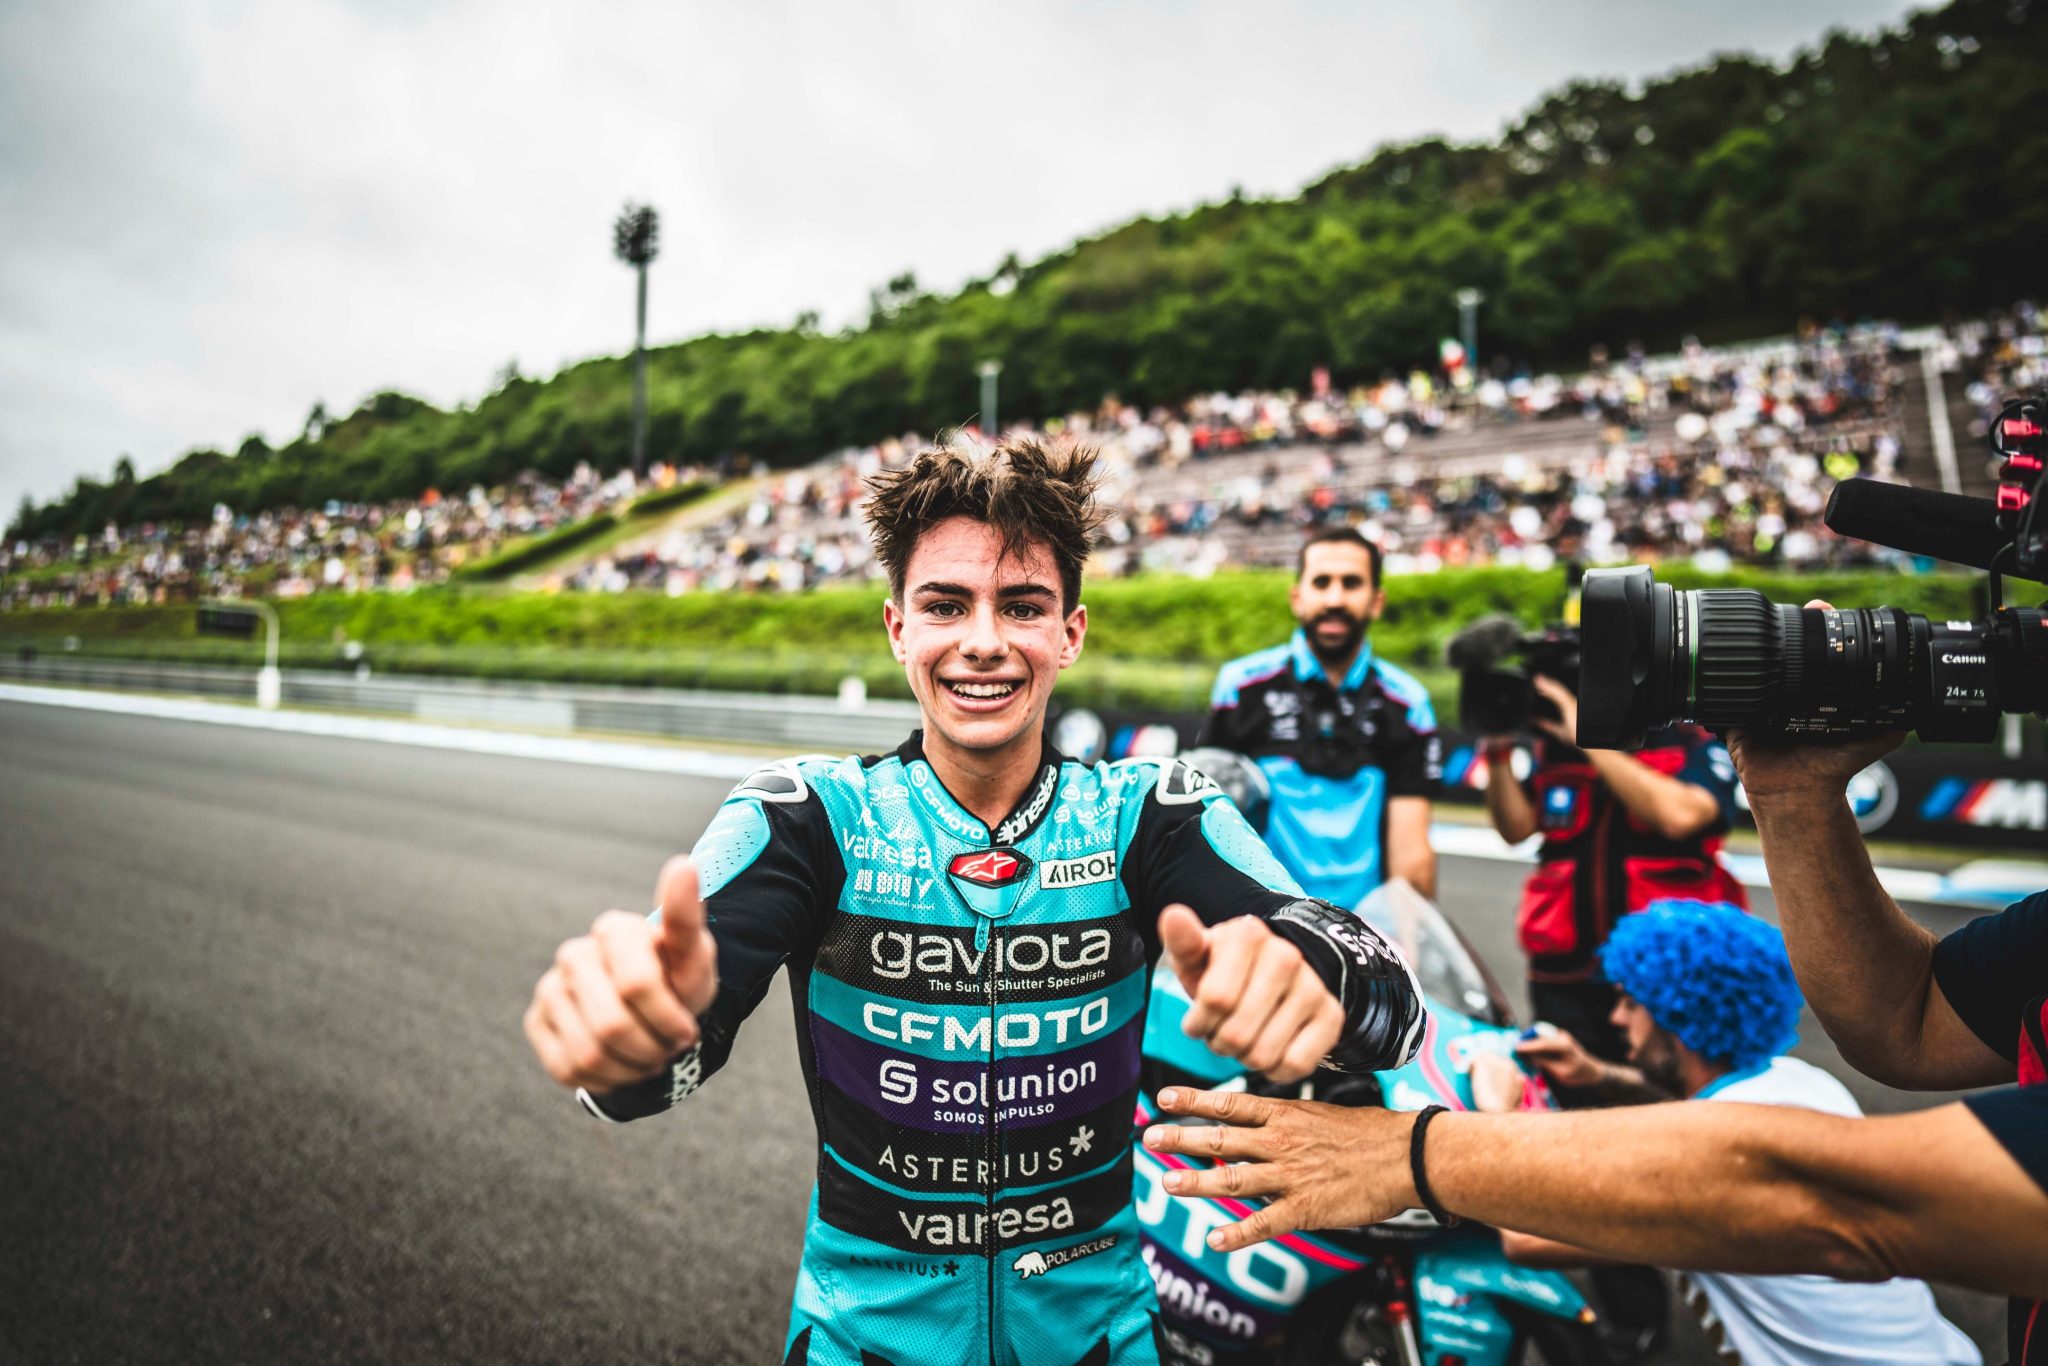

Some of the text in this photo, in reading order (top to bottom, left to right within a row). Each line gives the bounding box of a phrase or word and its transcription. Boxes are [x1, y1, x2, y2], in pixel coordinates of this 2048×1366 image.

[1941, 653, 1986, 664] Canon
[921, 787, 985, 841] CFMOTO
[842, 827, 933, 870] valresa
[1047, 828, 1117, 854] ASTERIU
[870, 928, 1111, 979] gaviota
[928, 979, 951, 991] The
[955, 980, 980, 993] Sun
[997, 978, 1045, 991] Shutter
[1047, 968, 1106, 988] Specialists
[863, 996, 1110, 1053] CFMOTO
[931, 1060, 1097, 1108] solunion
[933, 1110, 985, 1125] SOMOS
[878, 1144, 1063, 1185] ASTERIUS
[898, 1196, 1075, 1246] valresa
[849, 1254, 940, 1279] ASTERIUS
[1045, 1235, 1118, 1268] POLARCUBE
